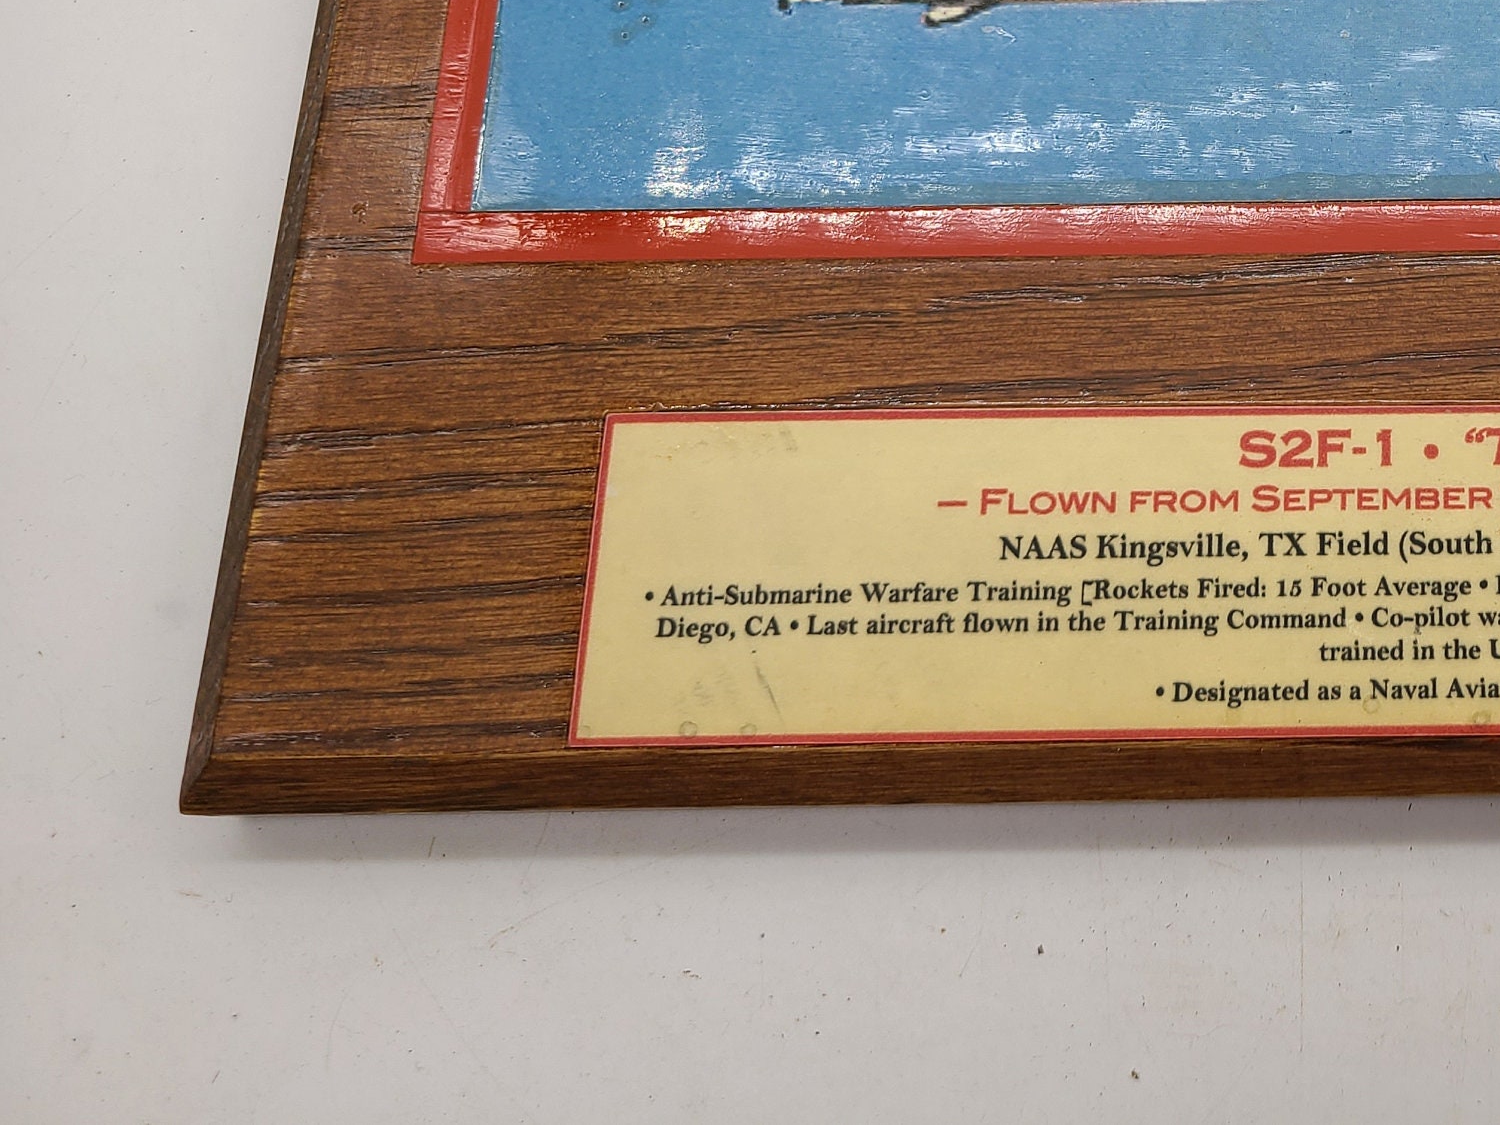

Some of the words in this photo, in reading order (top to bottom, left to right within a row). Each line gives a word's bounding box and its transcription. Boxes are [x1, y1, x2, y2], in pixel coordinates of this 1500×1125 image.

[1239, 428, 1392, 470] S2F-1
[979, 487, 1117, 516] FLOWN
[1129, 489, 1240, 514] FROM
[1251, 484, 1493, 514] SEPTEMBER
[999, 534, 1087, 560] NAAS
[1095, 532, 1249, 567] Kingsville,
[1258, 532, 1307, 557] TX
[1316, 530, 1389, 556] Field
[1399, 529, 1493, 563] (South
[660, 583, 852, 606] Anti-Submarine
[860, 582, 959, 603] Warfare
[966, 580, 1072, 608] Training
[1081, 578, 1189, 607] [Rockets
[1197, 576, 1266, 599] Fired:
[1277, 579, 1302, 597] 15
[1311, 576, 1367, 597] Foot
[1374, 575, 1472, 603] Average
[655, 617, 736, 644] Diego,
[744, 615, 781, 637] CA
[806, 614, 858, 636] Last
[866, 612, 955, 635] aircraft
[963, 612, 1029, 633] flown
[1037, 611, 1059, 632] in
[1067, 610, 1106, 632] the
[1113, 609, 1220, 637] Training
[1226, 606, 1346, 630] Command
[1371, 605, 1470, 635] Co-pilot
[1319, 639, 1404, 662] trained
[1412, 639, 1435, 661] in
[1442, 638, 1481, 660] the
[1172, 679, 1309, 708] Designated
[1317, 685, 1342, 701] as
[1349, 685, 1362, 701] a
[1369, 677, 1438, 700] Naval
